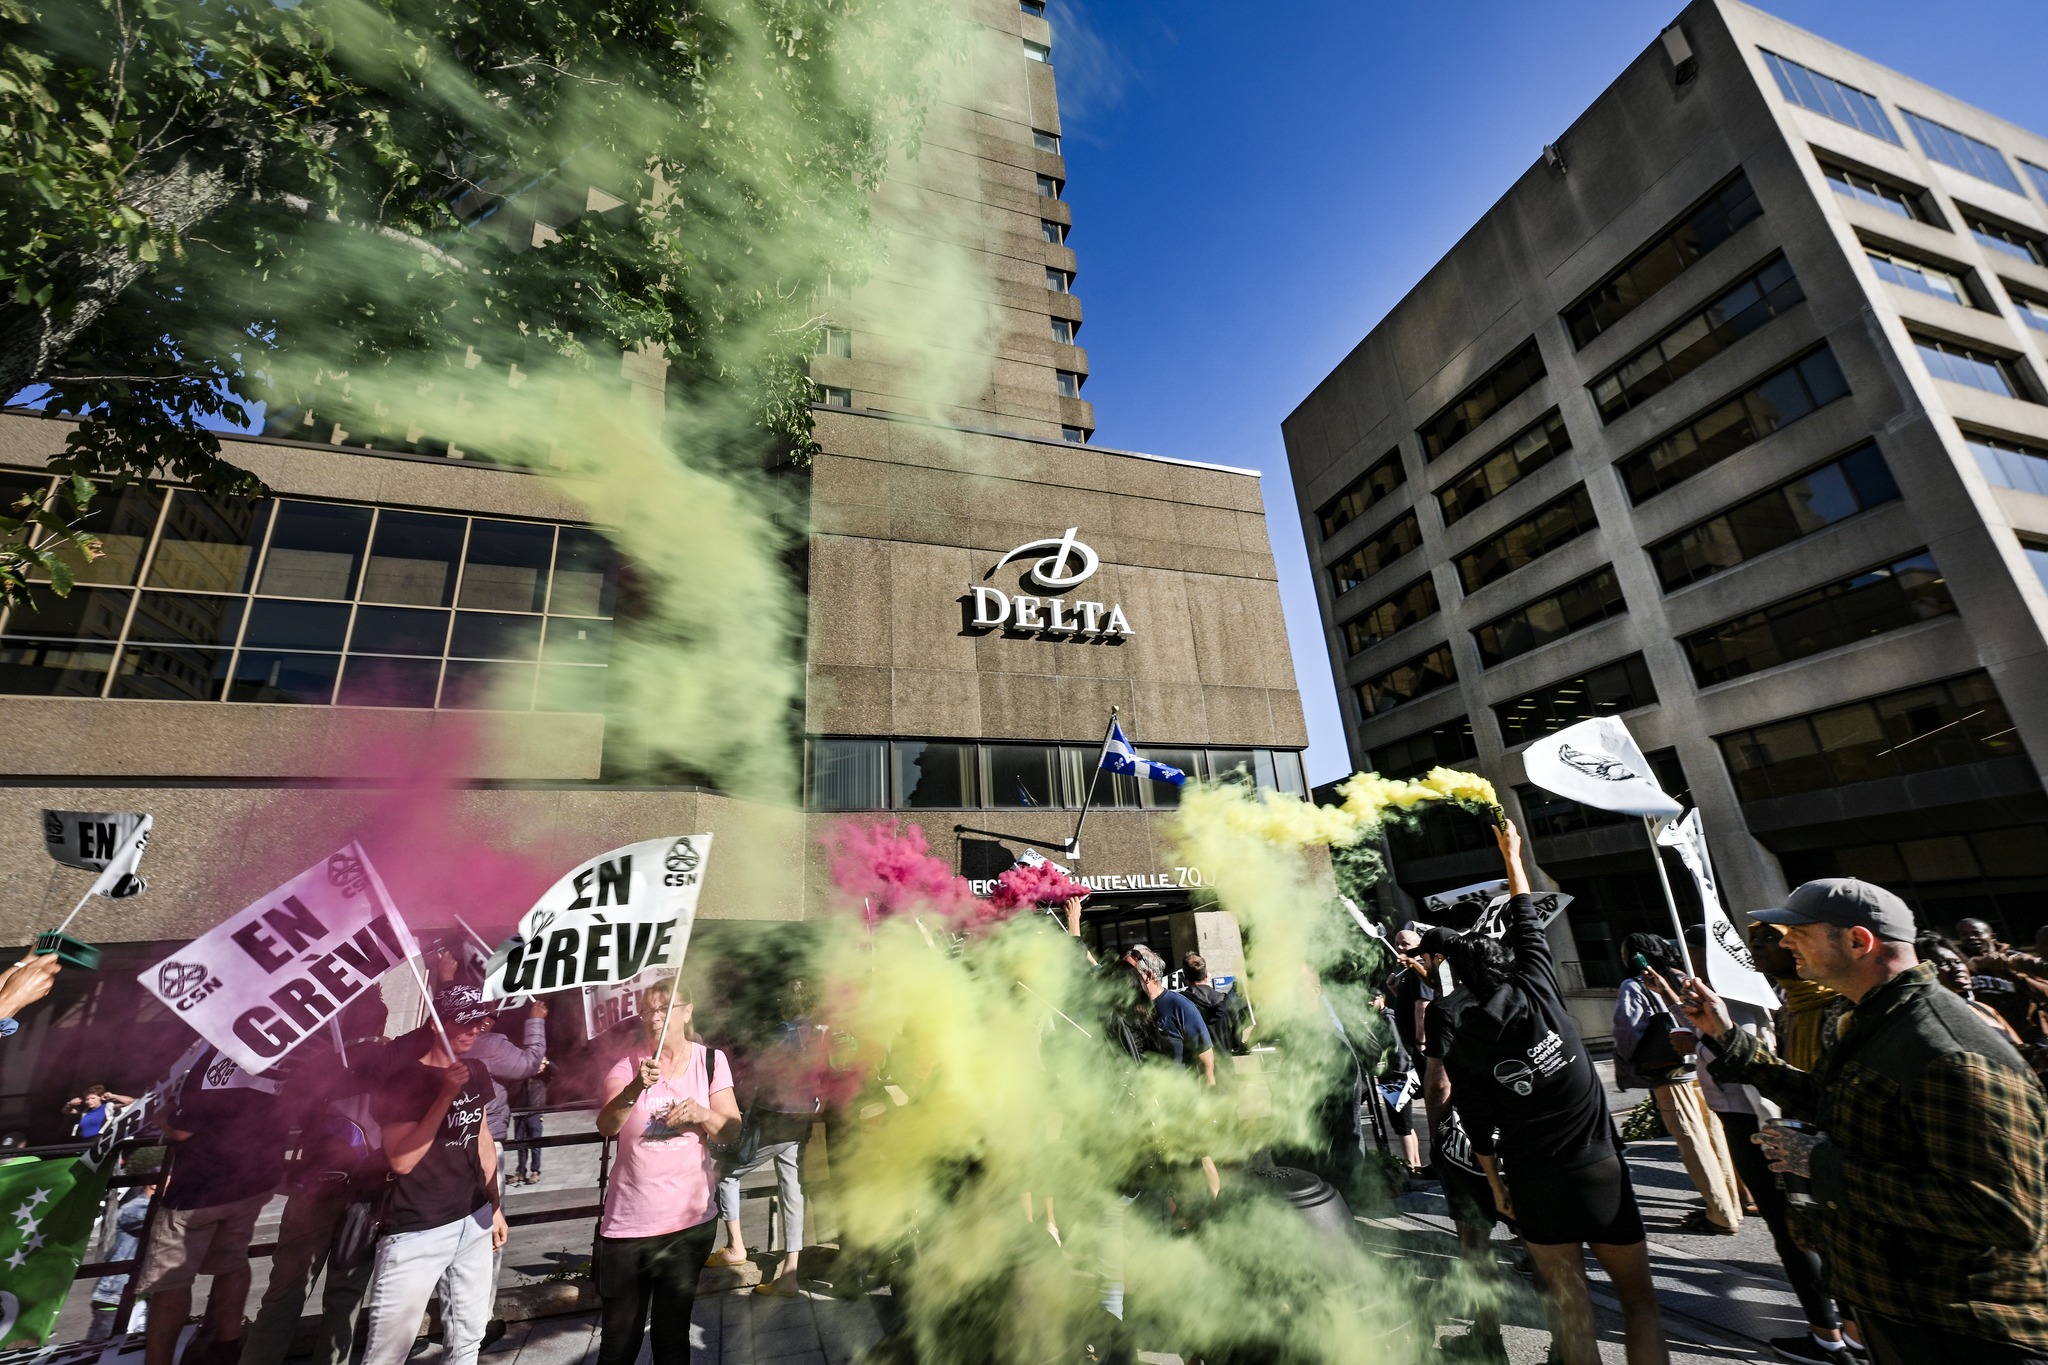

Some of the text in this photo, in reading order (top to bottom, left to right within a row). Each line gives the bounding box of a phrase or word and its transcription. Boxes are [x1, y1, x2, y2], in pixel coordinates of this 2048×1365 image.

[970, 585, 1136, 637] DELTA
[78, 821, 117, 860] EN
[567, 855, 632, 910] EN
[664, 873, 698, 887] CSN
[1069, 873, 1169, 891] HAUTE-VILLE
[231, 895, 330, 975] EN
[502, 914, 678, 992] GRÈVE
[175, 976, 224, 1012] CSN
